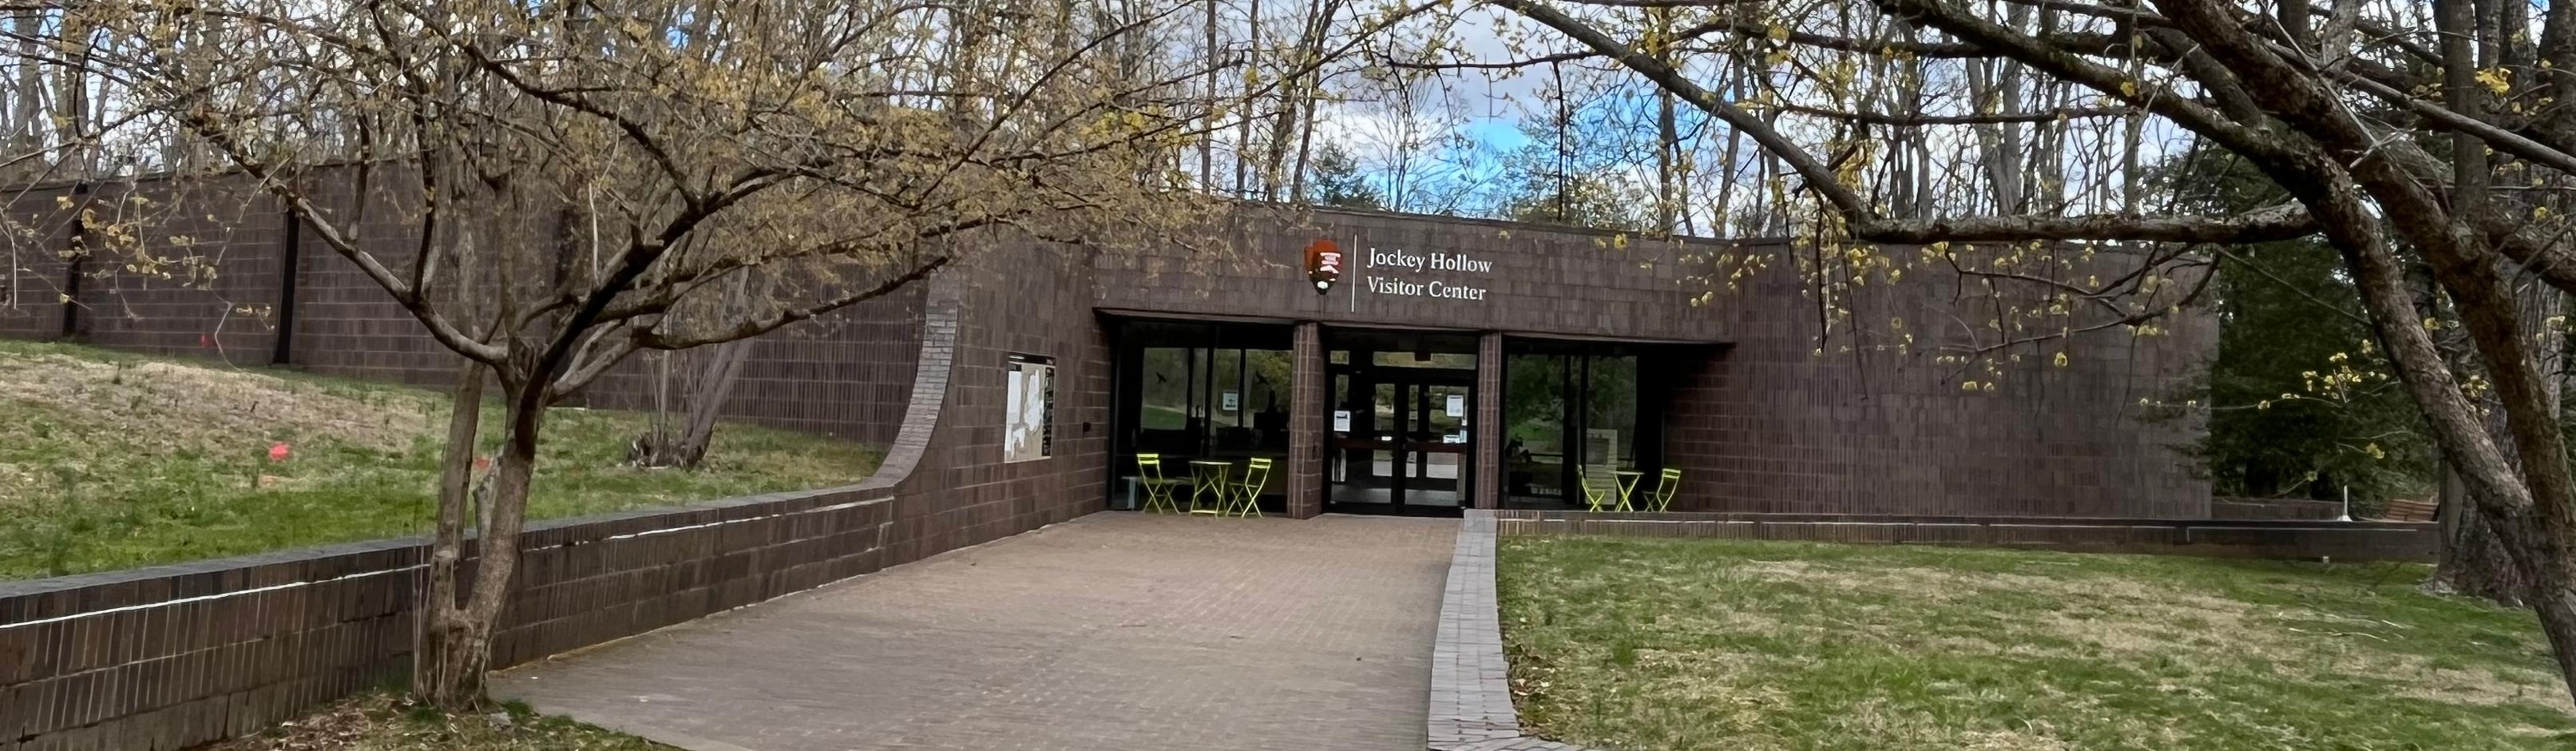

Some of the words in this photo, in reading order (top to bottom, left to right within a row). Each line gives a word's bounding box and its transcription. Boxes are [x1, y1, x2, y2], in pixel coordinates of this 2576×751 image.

[1367, 248, 1425, 272] Jockey
[1430, 252, 1492, 272] Hollow
[1367, 276, 1424, 296] Visitor
[1429, 280, 1486, 300] Center
